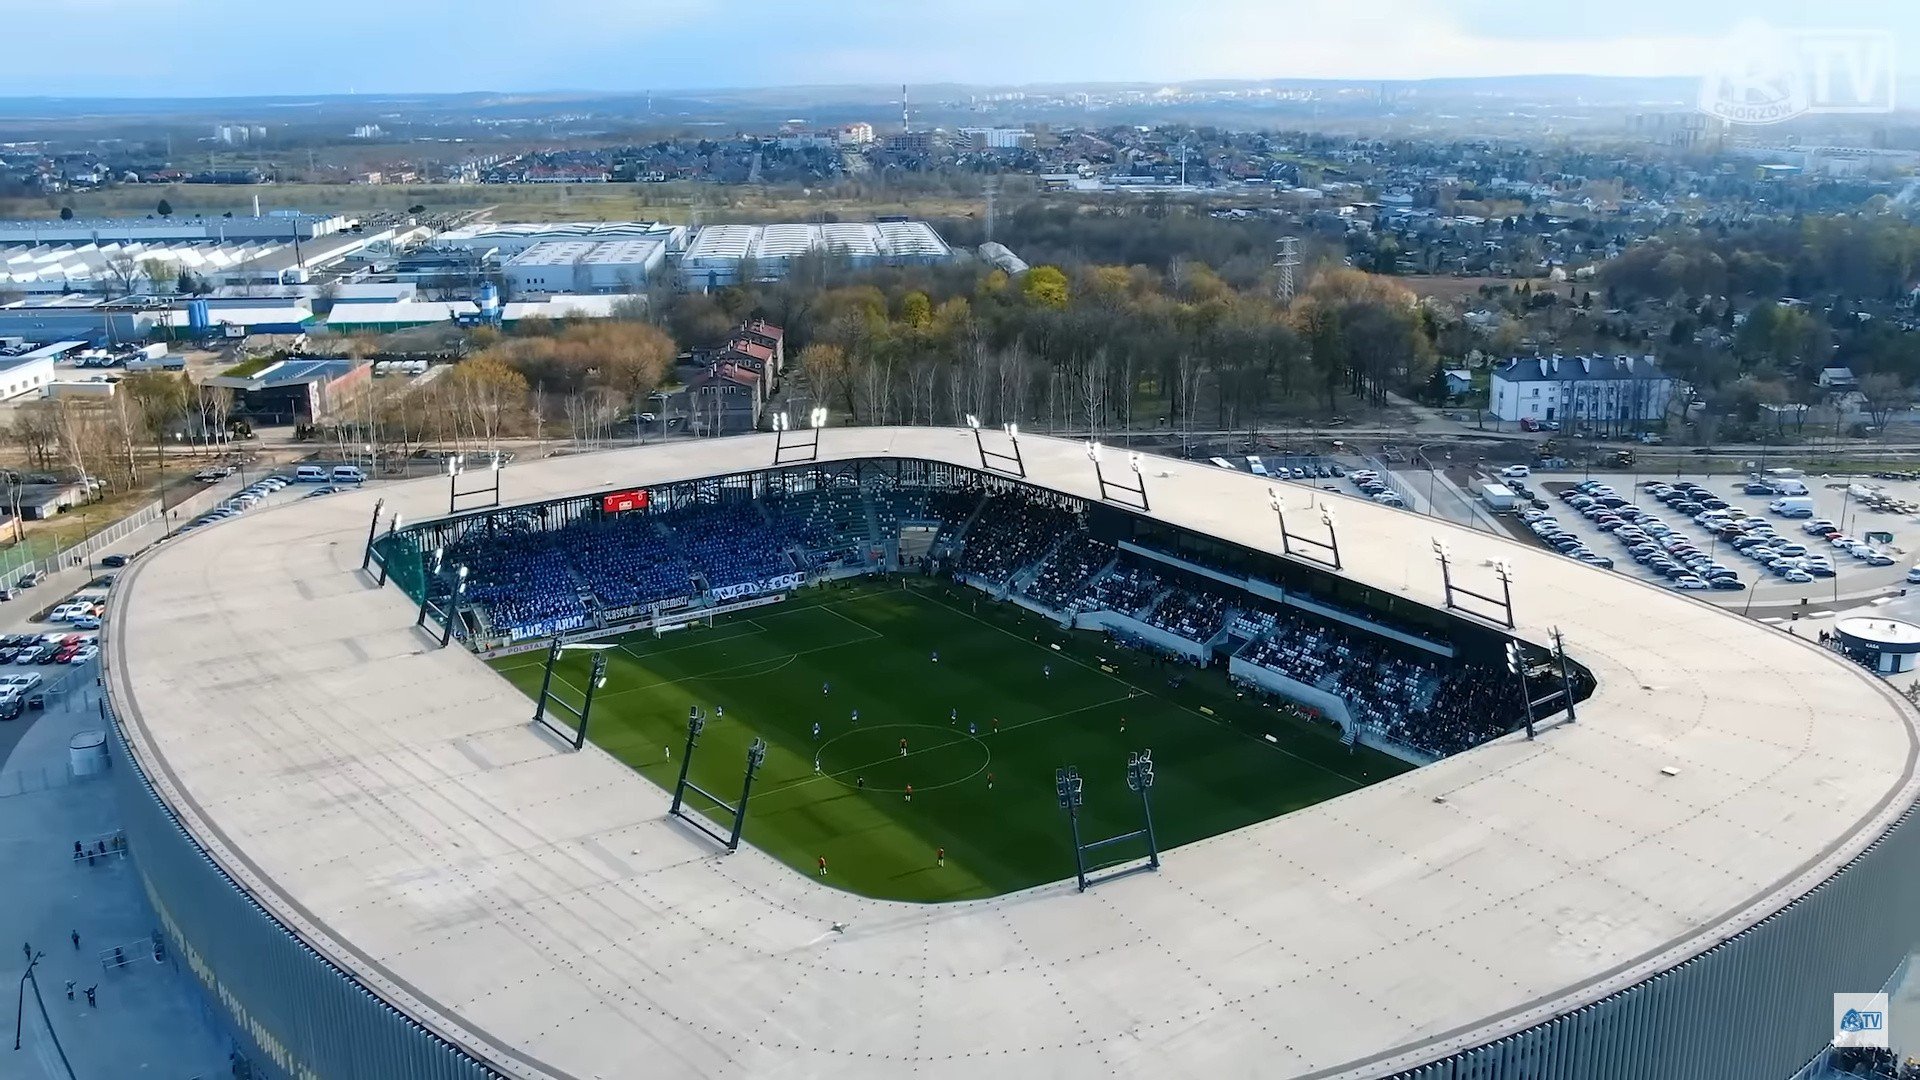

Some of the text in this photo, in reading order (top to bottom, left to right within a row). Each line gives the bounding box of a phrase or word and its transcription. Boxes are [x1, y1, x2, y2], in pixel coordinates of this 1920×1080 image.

[511, 614, 585, 641] BLUE ARMY
[507, 643, 543, 653] POLSTAL
